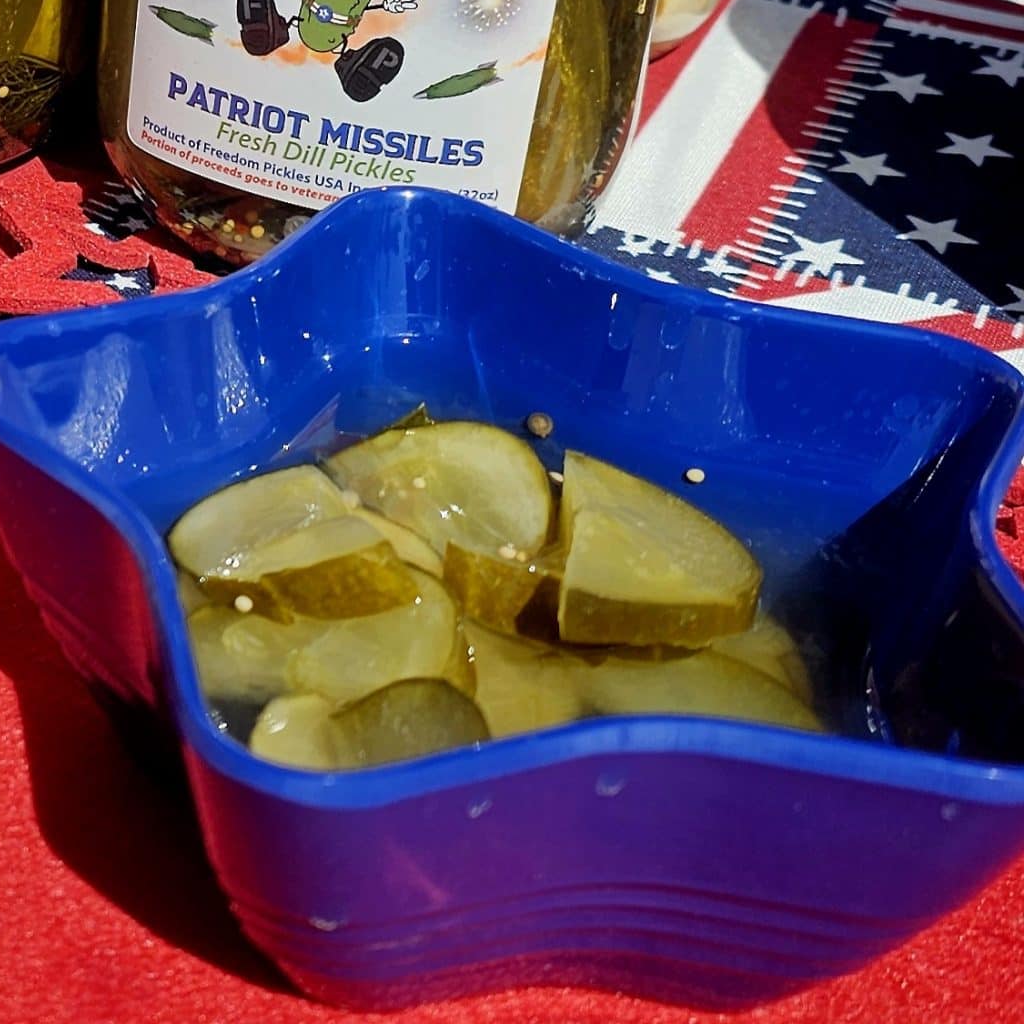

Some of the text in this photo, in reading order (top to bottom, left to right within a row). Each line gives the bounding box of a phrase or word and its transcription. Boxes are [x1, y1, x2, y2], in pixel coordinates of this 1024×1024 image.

[143, 116, 361, 193] Product of Freedom Pickles USA In
[167, 71, 485, 166] PATRIOT MISSILES
[216, 121, 417, 184] Fresh Dill Pickles
[141, 130, 340, 203] Portion of proceeds goes to veteran
